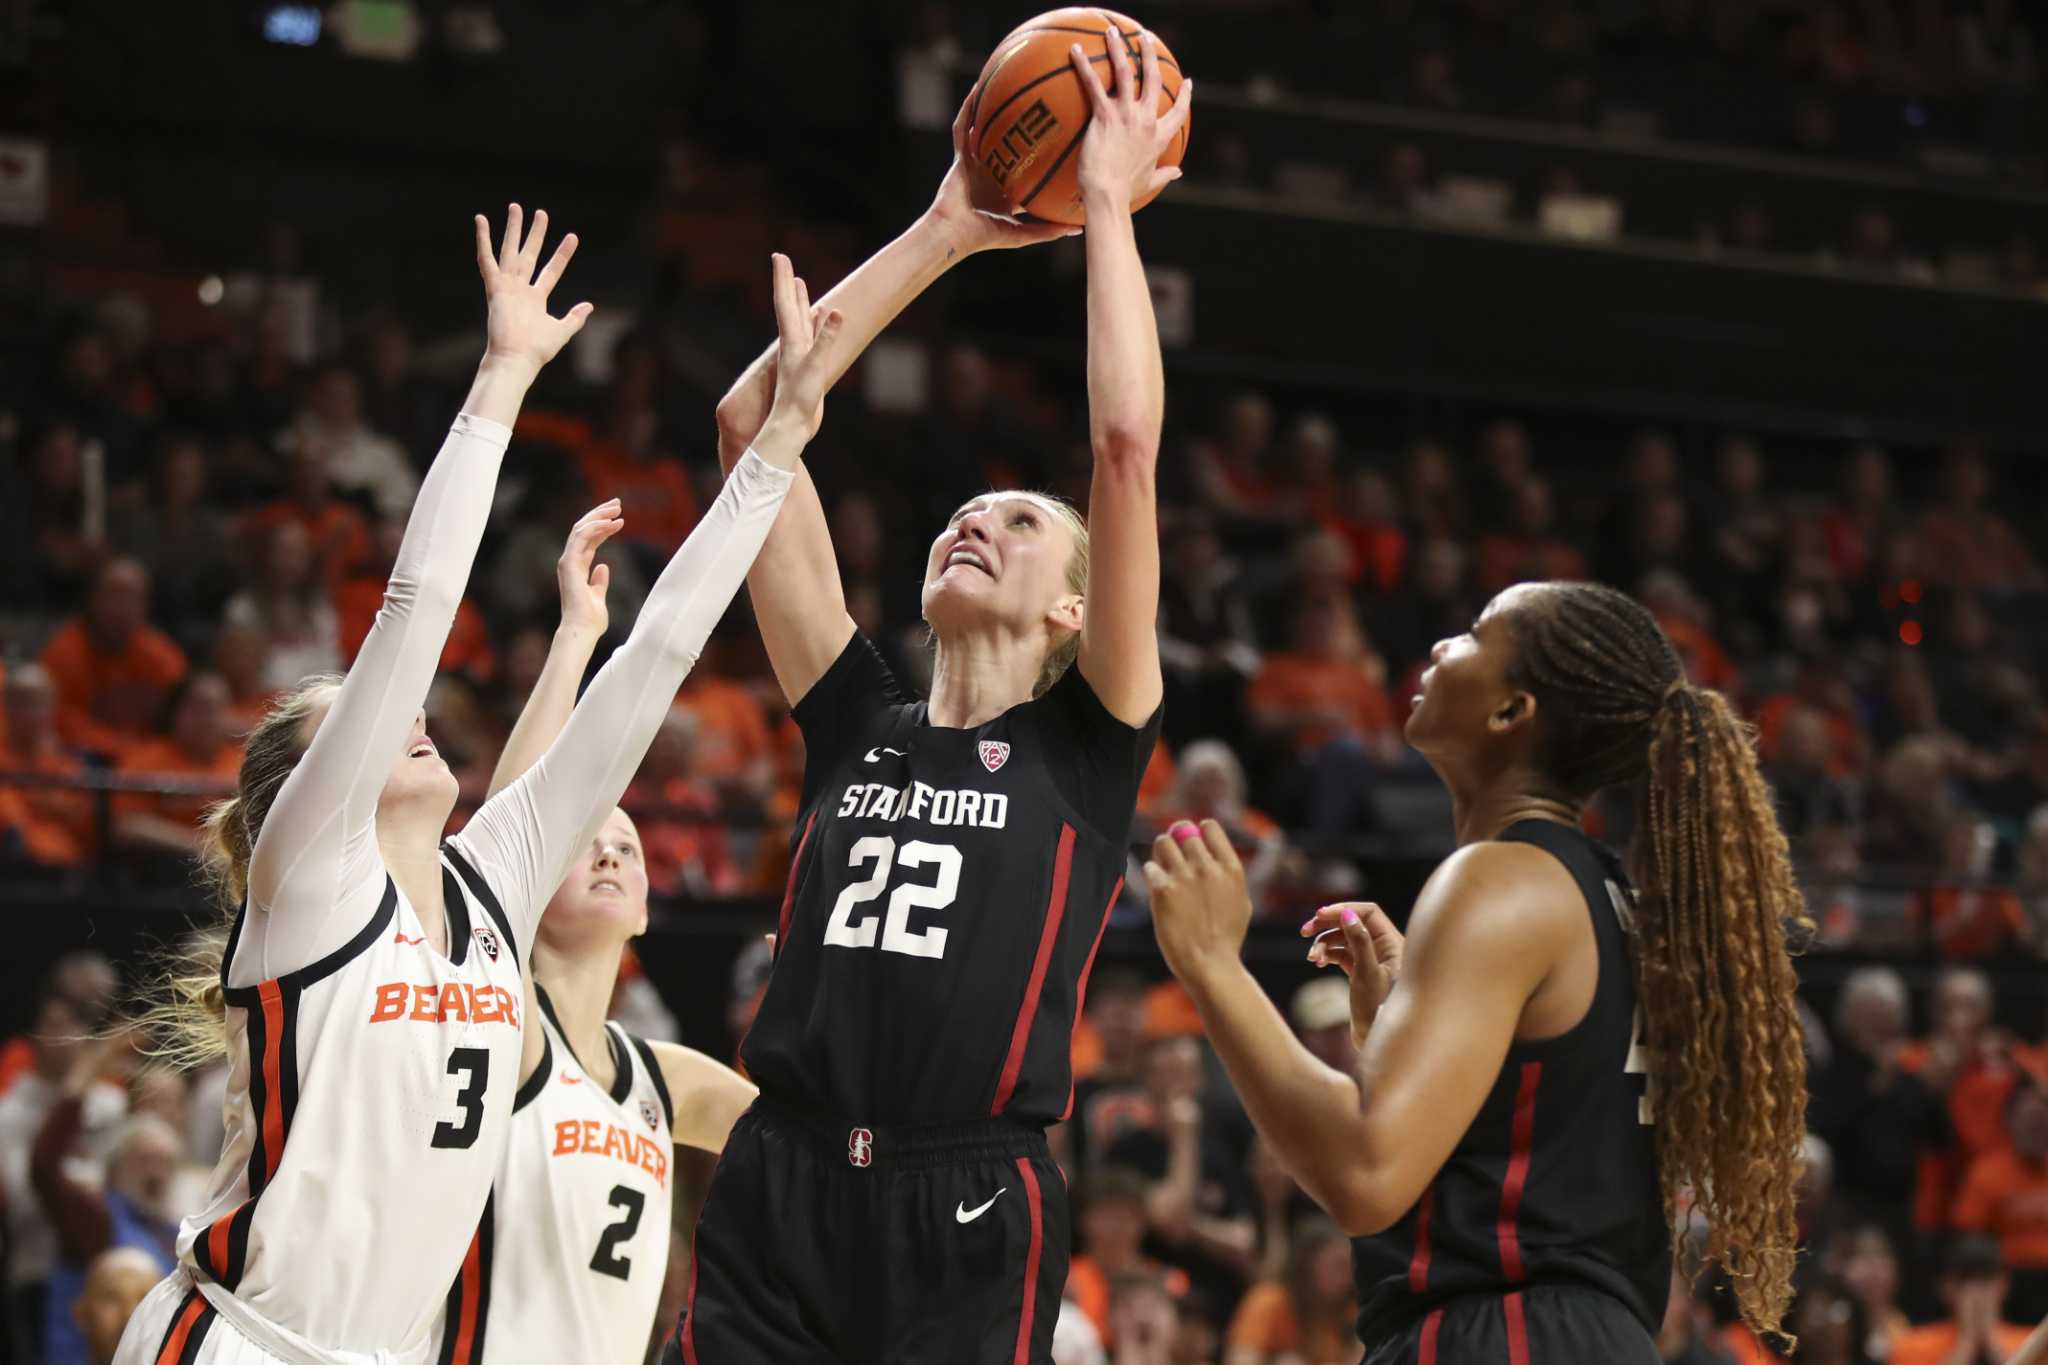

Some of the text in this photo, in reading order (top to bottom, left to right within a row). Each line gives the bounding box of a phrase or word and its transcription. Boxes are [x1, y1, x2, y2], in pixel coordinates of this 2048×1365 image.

[985, 99, 1057, 184] ELITE
[823, 836, 963, 960] 22
[430, 1048, 489, 1149] 3
[589, 1184, 645, 1281] 2
